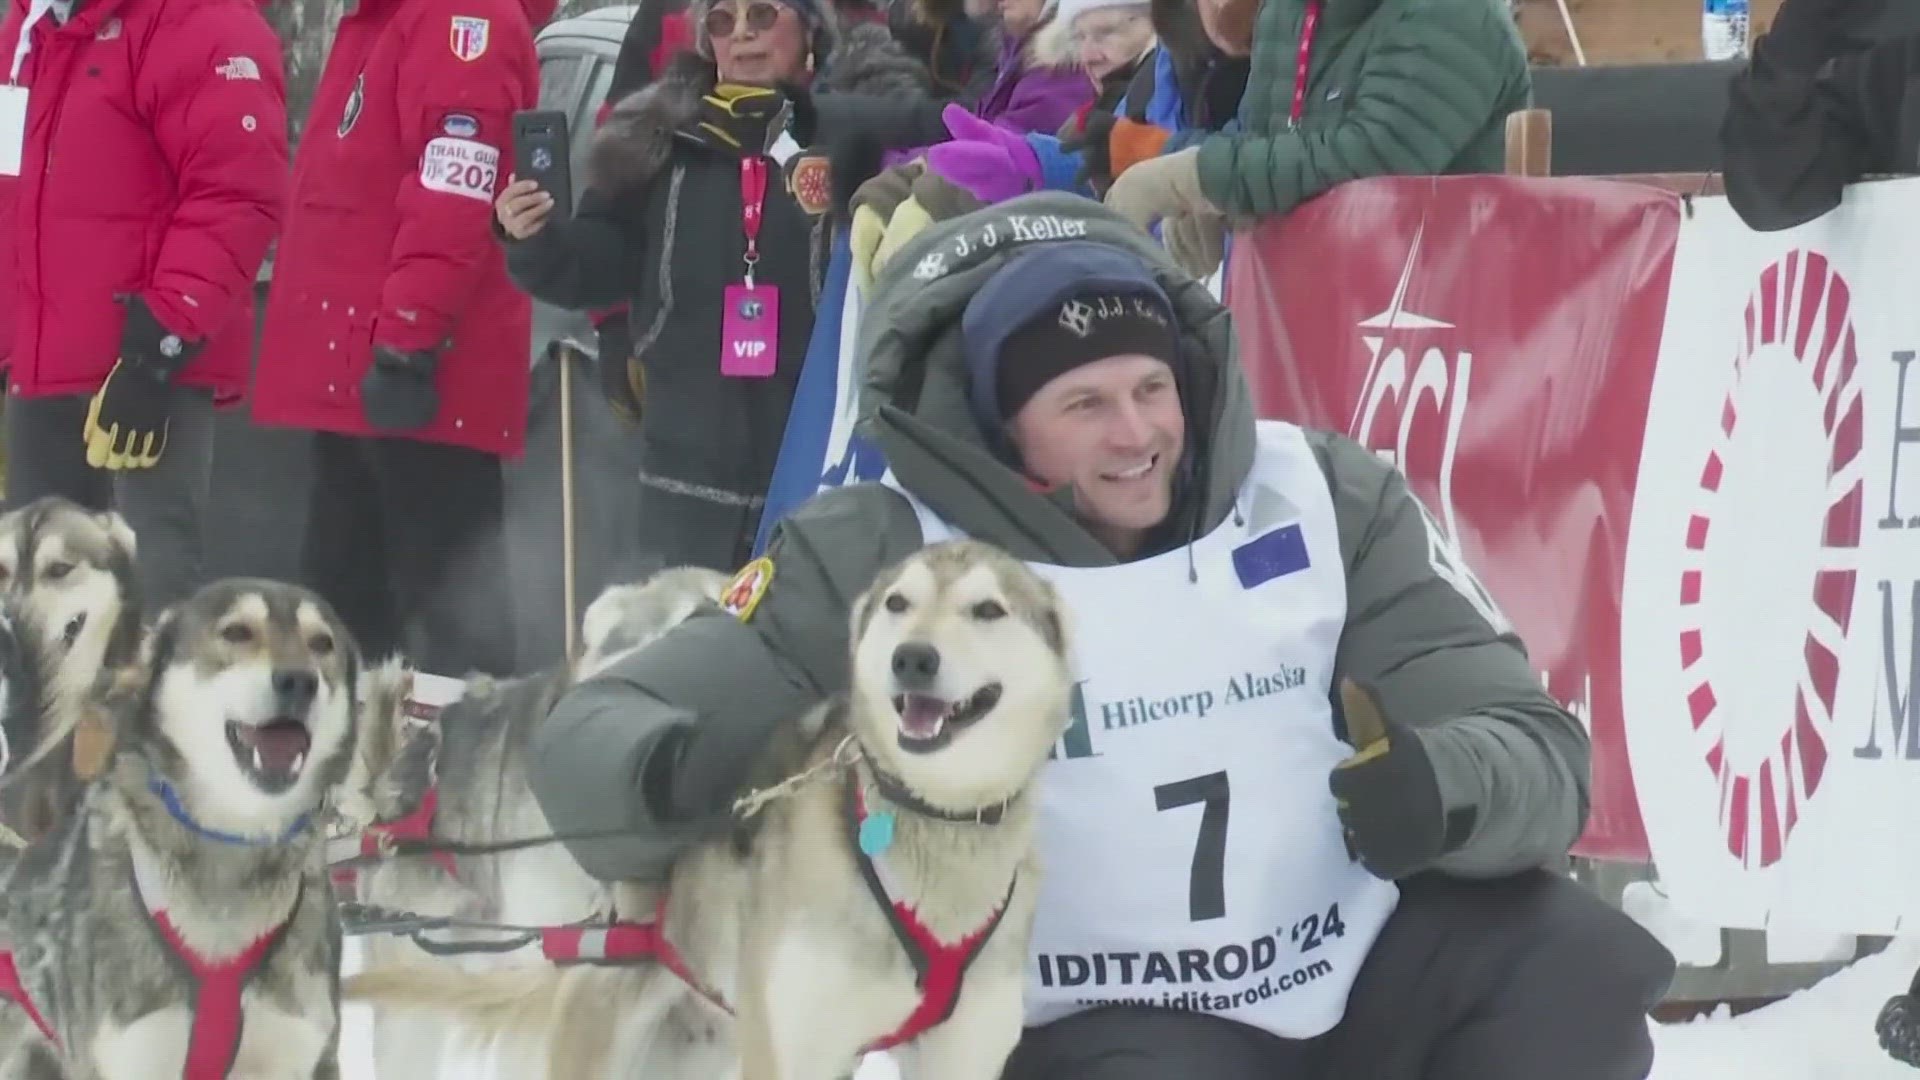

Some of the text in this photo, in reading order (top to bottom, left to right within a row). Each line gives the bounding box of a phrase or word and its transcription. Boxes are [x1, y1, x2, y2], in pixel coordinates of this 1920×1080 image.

[430, 145, 469, 160] TRAIL
[1008, 214, 1087, 242] Keller
[733, 340, 766, 357] VIP
[1101, 689, 1213, 730] Hilcorp
[1223, 663, 1306, 704] Alaska
[1153, 769, 1230, 922] 7
